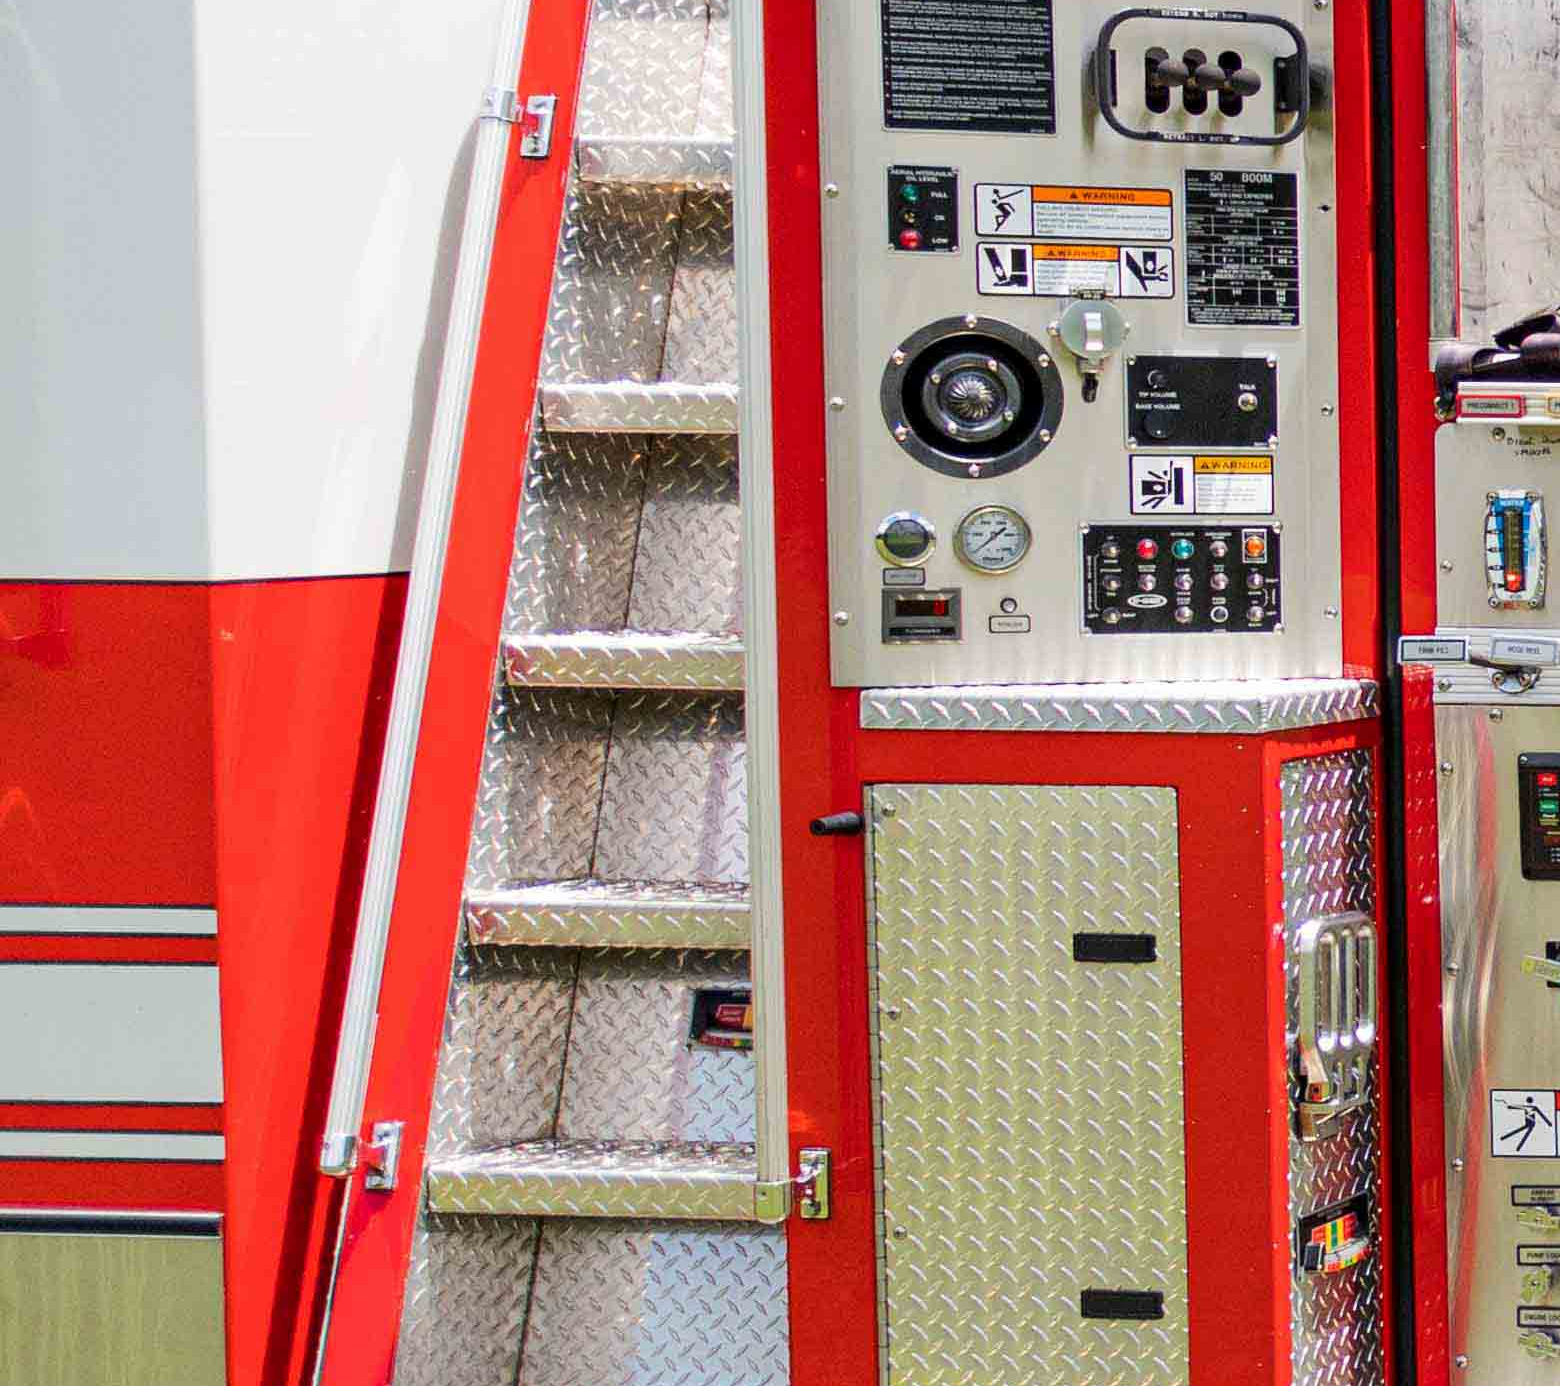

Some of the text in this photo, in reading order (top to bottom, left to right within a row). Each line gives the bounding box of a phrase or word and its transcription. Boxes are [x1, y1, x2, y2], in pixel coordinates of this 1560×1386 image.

[1241, 172, 1273, 183] BOOM
[930, 190, 949, 198] FULL
[1082, 191, 1136, 203] WARNING
[931, 237, 949, 245] LOW
[1212, 460, 1269, 470] WARNING
